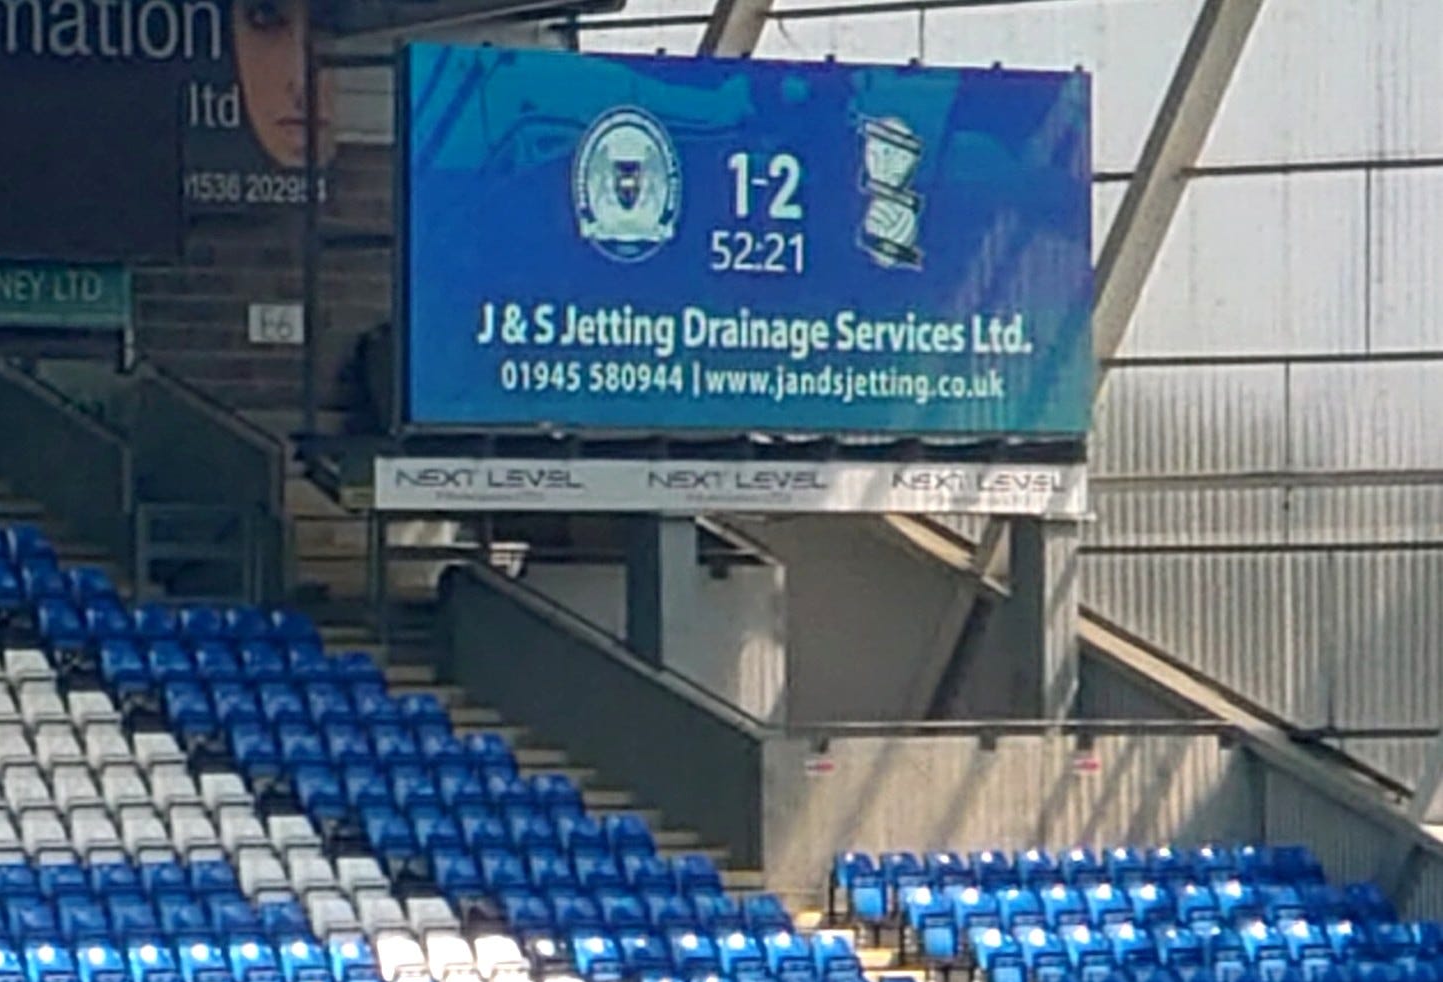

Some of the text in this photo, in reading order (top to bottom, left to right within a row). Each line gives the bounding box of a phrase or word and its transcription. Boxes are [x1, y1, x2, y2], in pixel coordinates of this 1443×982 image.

[189, 82, 240, 127] ltd
[728, 152, 803, 219] 1-2
[711, 230, 805, 274] 52:21
[53, 270, 102, 301] LTD
[477, 302, 1032, 359] J & S Jetting Drainage Services Ltd.
[501, 360, 582, 392] 01945
[588, 361, 684, 393] 580944
[705, 363, 1005, 404] www.jandsjetting.co.uk
[395, 469, 584, 488] NEXT LEVEL
[648, 470, 828, 489] NEXT LEVEL
[892, 472, 1067, 492] NEXT LEVEL
